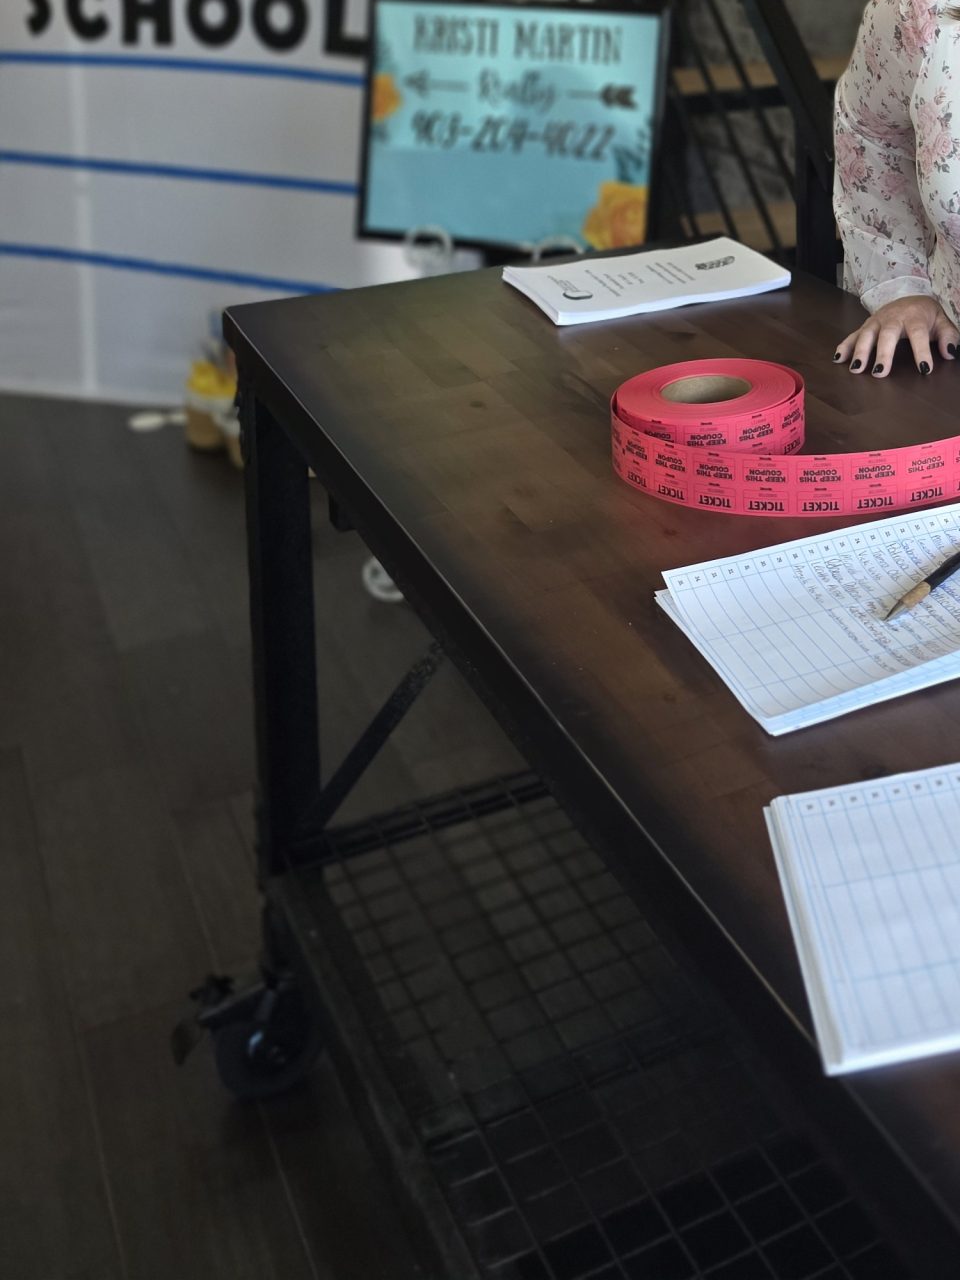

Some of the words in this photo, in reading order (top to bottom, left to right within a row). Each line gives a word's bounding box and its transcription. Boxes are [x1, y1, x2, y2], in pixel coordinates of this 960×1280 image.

[413, 15, 499, 56] KRISTI
[513, 20, 623, 64] MARTIN
[742, 423, 770, 435] COUPON
[756, 428, 774, 438] KEEP
[739, 434, 755, 442] THIS
[655, 458, 668, 468] THIS
[658, 453, 683, 465] COUPON
[911, 455, 942, 466] COUPON
[669, 463, 686, 473] KEEP
[699, 463, 729, 473] COUPON
[859, 464, 892, 473] COUPON
[908, 464, 925, 474] THIS
[926, 460, 945, 471] KEEP
[696, 469, 712, 477] THIS
[712, 471, 733, 480] KEEP
[874, 470, 896, 479] KEEP
[627, 471, 647, 488] TICKET
[657, 483, 685, 500] TICKET
[910, 486, 944, 502] TICKET
[698, 494, 732, 508] TICKET
[748, 500, 785, 512] TICKET
[802, 501, 840, 512] TICKET
[857, 496, 894, 509] TICKET
